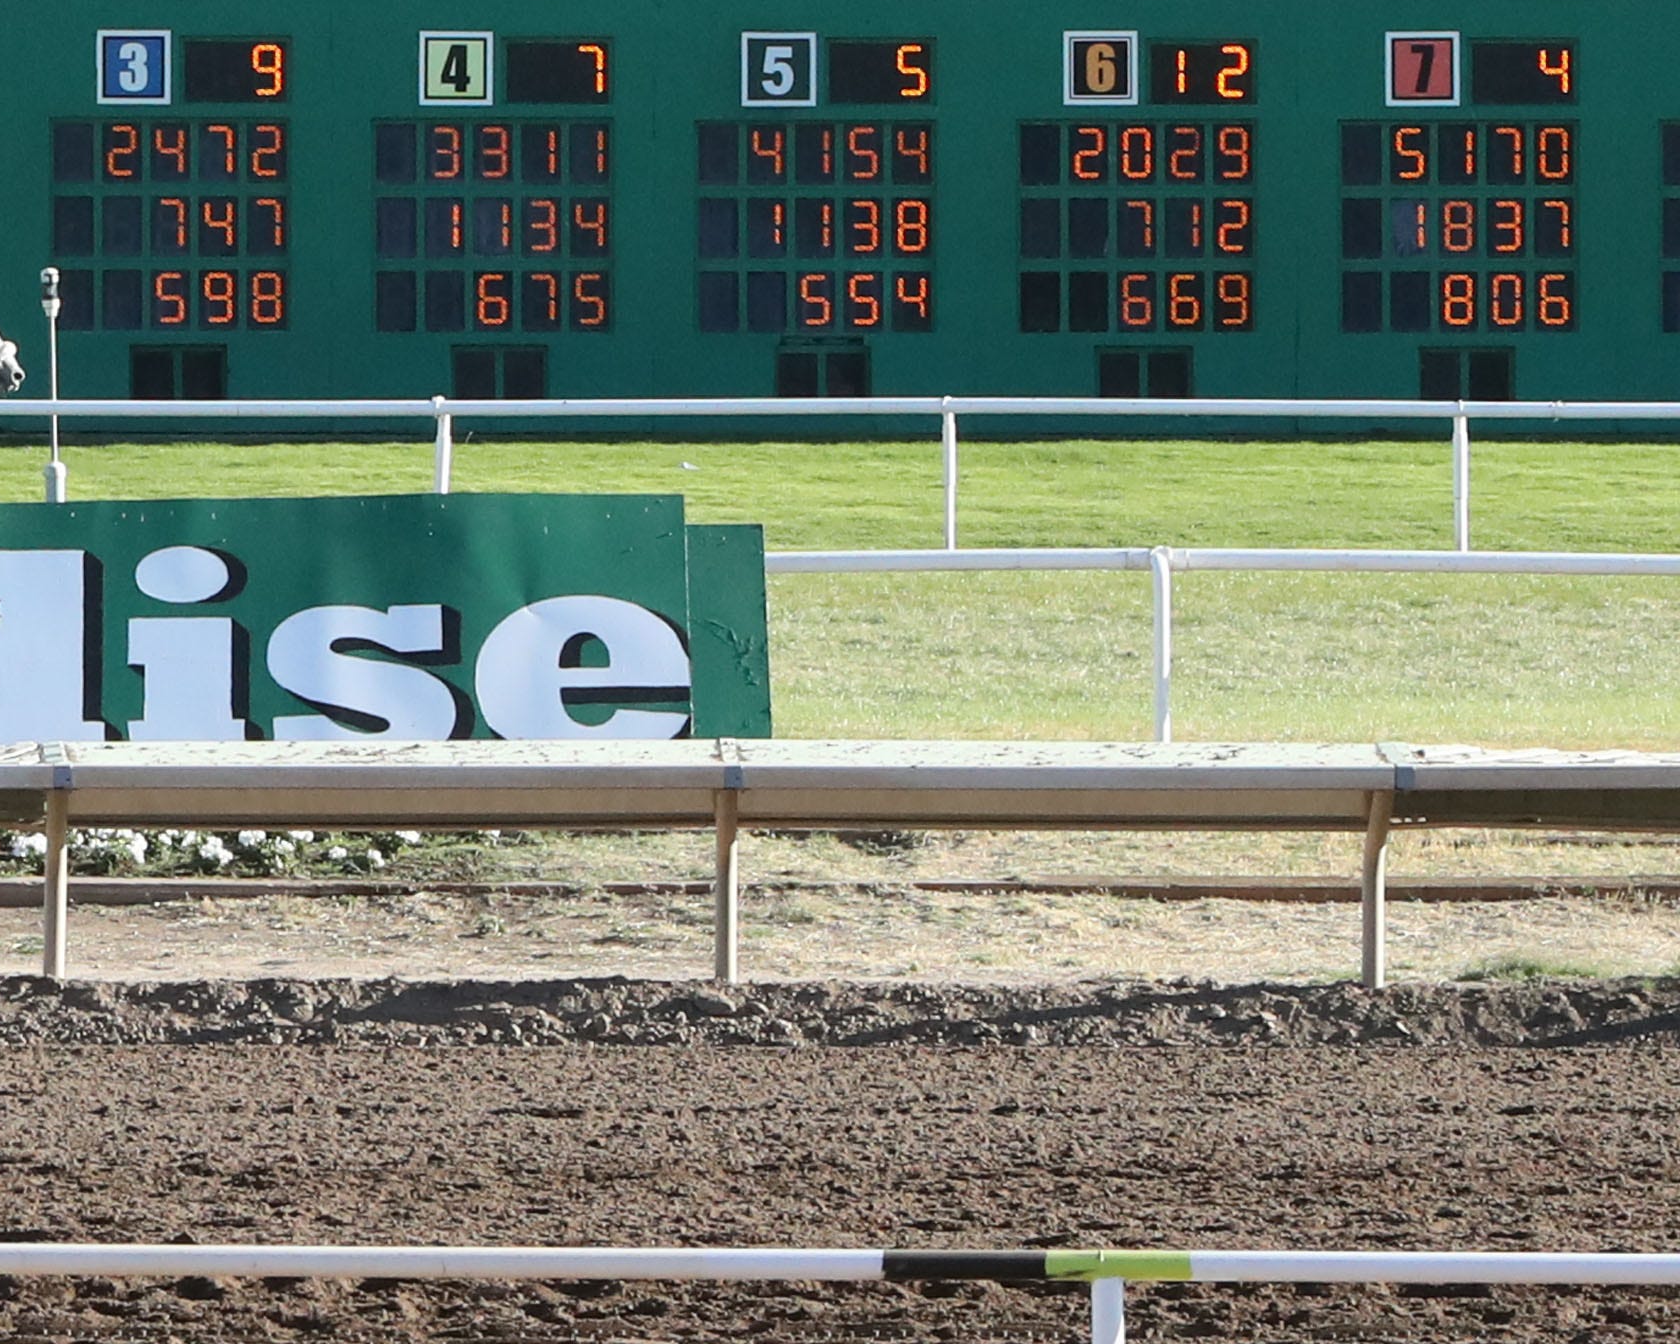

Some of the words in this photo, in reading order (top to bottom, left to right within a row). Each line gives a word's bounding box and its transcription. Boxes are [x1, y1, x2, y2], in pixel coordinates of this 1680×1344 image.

[118, 42, 150, 94] 3
[251, 44, 283, 97] 9
[440, 43, 472, 94] 4
[578, 44, 607, 94] 7
[760, 45, 796, 96] 5
[896, 44, 929, 97] 5
[1084, 43, 1116, 94] 6
[1176, 44, 1249, 98] 12
[1409, 43, 1436, 94] 7
[1538, 47, 1569, 94] 4
[107, 125, 282, 177] 2472
[433, 126, 606, 178] 3311
[751, 127, 928, 178] 4154
[1073, 127, 1249, 179] 2029
[1395, 127, 1569, 180] 5170
[160, 198, 283, 247] 747
[450, 201, 605, 251] 1134
[772, 200, 928, 253] 1138
[1126, 200, 1249, 252] 712
[1414, 200, 1570, 253] 1837
[154, 272, 283, 324] 598
[477, 274, 605, 325] 675
[800, 274, 928, 326] 554
[1122, 274, 1249, 325] 669
[1443, 274, 1570, 326] 806
